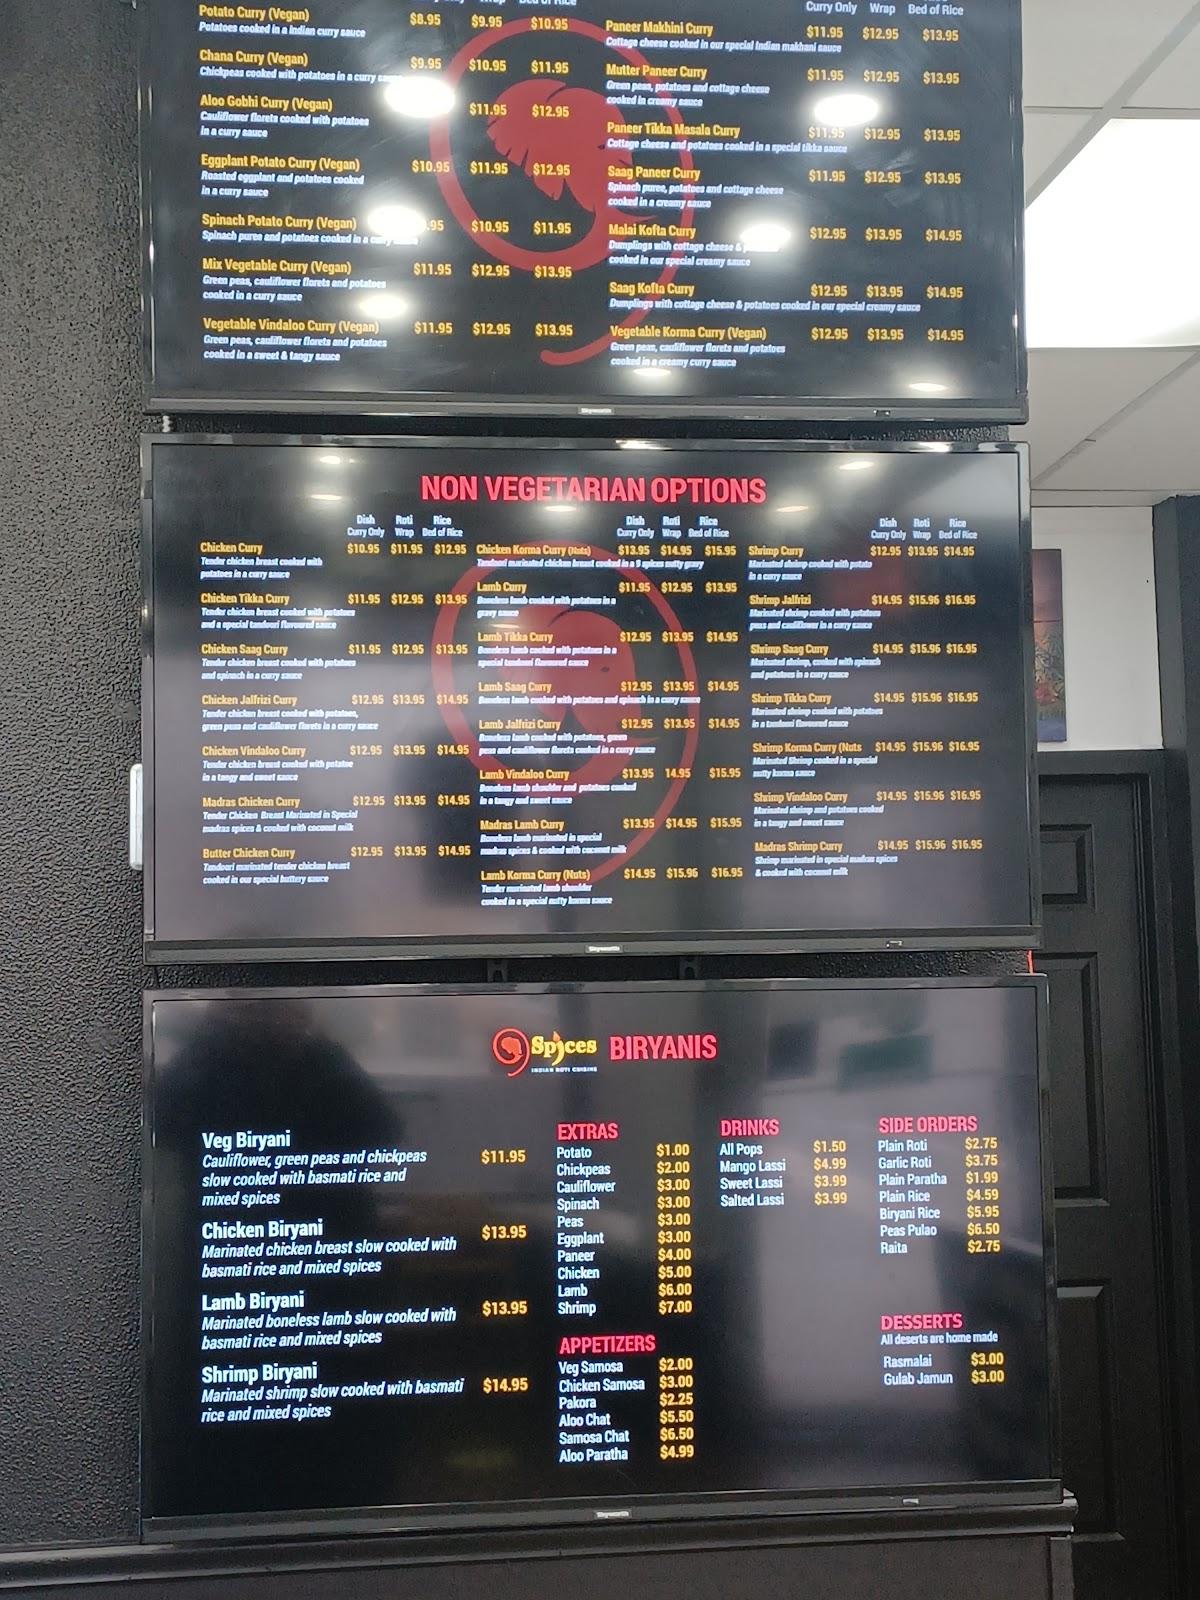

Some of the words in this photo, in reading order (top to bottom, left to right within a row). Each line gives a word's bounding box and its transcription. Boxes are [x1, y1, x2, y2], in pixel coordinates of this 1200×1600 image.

[198, 4, 235, 17] Potato
[236, 6, 266, 21] Curry
[268, 7, 309, 23] (Vegan)
[805, 0, 833, 14] Curry
[834, 1, 857, 15] Only
[869, 2, 895, 16] Wrap
[907, 3, 927, 14] Bed
[928, 3, 940, 15] of
[941, 3, 964, 15] Rice
[409, 12, 441, 26] $8.95
[471, 14, 502, 28] $9.95
[530, 15, 568, 31] $10.95
[605, 19, 641, 32] Paneer
[642, 20, 684, 34] Makhini
[685, 22, 713, 37] Curry
[806, 24, 843, 39] $11.95
[862, 26, 899, 40] $12.95
[922, 28, 958, 42] $13.95
[199, 48, 233, 62] Chana
[235, 50, 264, 66] Curry
[266, 51, 308, 67] (Vegan)
[410, 56, 442, 70] $9.95
[468, 57, 506, 72] $10.95
[531, 59, 568, 74] $11.95
[199, 93, 225, 106] Aloo
[226, 94, 258, 107] Gobhi
[260, 96, 289, 111] Curry
[291, 96, 333, 113] (Vegan)
[468, 101, 507, 116] $11.95
[531, 103, 569, 118] $12.95
[202, 257, 222, 269] Mix
[224, 257, 277, 274] Vegetable
[279, 259, 308, 274] Curry
[310, 259, 352, 275] (Vegan)
[609, 281, 635, 296] Saag
[637, 281, 665, 294] Kofta
[666, 282, 695, 297] Curry
[609, 324, 661, 340] Vegetable
[662, 325, 696, 337] Korma
[697, 326, 726, 340] Curry
[727, 326, 767, 341] (Vegan)
[421, 475, 477, 500] NON
[484, 475, 645, 503] VEGETARIAN
[650, 476, 767, 503] OPTIONS
[356, 513, 375, 524] Dish
[395, 514, 413, 525] Roti
[432, 514, 452, 525] Rice
[200, 541, 237, 552] Chicken
[237, 542, 263, 555] Curry
[347, 542, 380, 554] $10.95
[390, 543, 423, 554] $11.95
[434, 543, 466, 555] $12.95
[749, 594, 780, 606] Shrimp
[781, 594, 811, 604] Jalfrizi
[871, 594, 902, 605] $14.95
[908, 594, 940, 605] $15.96
[944, 594, 976, 605] $16.95
[201, 694, 238, 705] Chicken
[239, 694, 271, 705] Jalfrizi
[272, 694, 298, 707] Curry
[479, 768, 504, 779] Lamb
[505, 768, 544, 779] Vindaloo
[545, 768, 570, 781] Curry
[621, 768, 654, 779] $13.95
[664, 768, 691, 778] 14.95
[709, 767, 741, 779] $15.95
[202, 848, 231, 858] Butter
[232, 847, 269, 857] Chicken
[270, 847, 295, 859] Curry
[350, 845, 383, 857] $12.95
[393, 845, 426, 857] $13.95
[437, 844, 471, 856] $14.95
[754, 841, 786, 851] Madras
[787, 840, 818, 853] Shrimp
[819, 840, 843, 853] Curry
[480, 869, 506, 880] Lamb
[506, 870, 536, 880] Korma
[537, 869, 561, 881] Curry
[562, 869, 590, 881] (Nuts)
[609, 1034, 716, 1060] BIRYANIS
[557, 1122, 618, 1140] EXTRAS
[720, 1118, 779, 1136] DRINKS
[878, 1116, 913, 1133] SIDE
[916, 1115, 977, 1133] ORDERS
[201, 1131, 232, 1153] Veg
[236, 1129, 290, 1152] Biryani
[813, 1139, 846, 1153] $1.50
[877, 1138, 904, 1152] Plain
[906, 1138, 927, 1151] Roti
[964, 1135, 997, 1150] $2.75
[481, 1148, 525, 1164] $11.95
[556, 1146, 592, 1158] Potato
[656, 1142, 689, 1157] $1.00
[719, 1142, 734, 1155] All
[735, 1142, 763, 1158] Pops
[202, 1152, 271, 1169] Cauliflower,
[273, 1154, 309, 1169] green
[309, 1153, 340, 1168] peas
[341, 1149, 366, 1164] and
[366, 1148, 427, 1166] chickpeas
[719, 1159, 756, 1175] Mango
[758, 1157, 786, 1171] Lassi
[813, 1156, 846, 1171] $4.99
[879, 1206, 915, 1222] Biryani
[917, 1205, 940, 1219] Rice
[966, 1204, 999, 1219] $5.95
[201, 1220, 264, 1239] Chicken
[268, 1217, 323, 1241] Biryani
[481, 1223, 526, 1240] $13.95
[201, 1292, 246, 1311] Lamb
[249, 1289, 304, 1313] Biryani
[557, 1300, 596, 1317] Shrimp
[658, 1298, 692, 1315] $7.00
[881, 1313, 962, 1330] DESSERTS
[559, 1334, 656, 1354] APPETIZERS
[879, 1333, 893, 1345] All
[894, 1332, 928, 1345] deserts
[929, 1334, 944, 1344] are
[945, 1331, 971, 1343] home
[972, 1330, 998, 1342] made
[658, 1356, 693, 1372] $2.00
[883, 1353, 932, 1368] Rasmalai
[970, 1351, 1004, 1366] $3.00
[201, 1364, 258, 1386] Shrimp
[262, 1361, 317, 1384] Biryani
[557, 1361, 579, 1377] Veg
[580, 1359, 623, 1373] Samosa
[883, 1371, 915, 1385] Gulab
[916, 1371, 953, 1384] Jamun
[971, 1369, 1004, 1384] $3.00
[200, 1407, 225, 1422] rice
[226, 1405, 252, 1421] and
[252, 1403, 291, 1420] mixed
[291, 1402, 331, 1421] spices
[558, 1448, 584, 1462] Aloo
[585, 1446, 628, 1461] Paratha
[659, 1443, 694, 1459] $4.99
